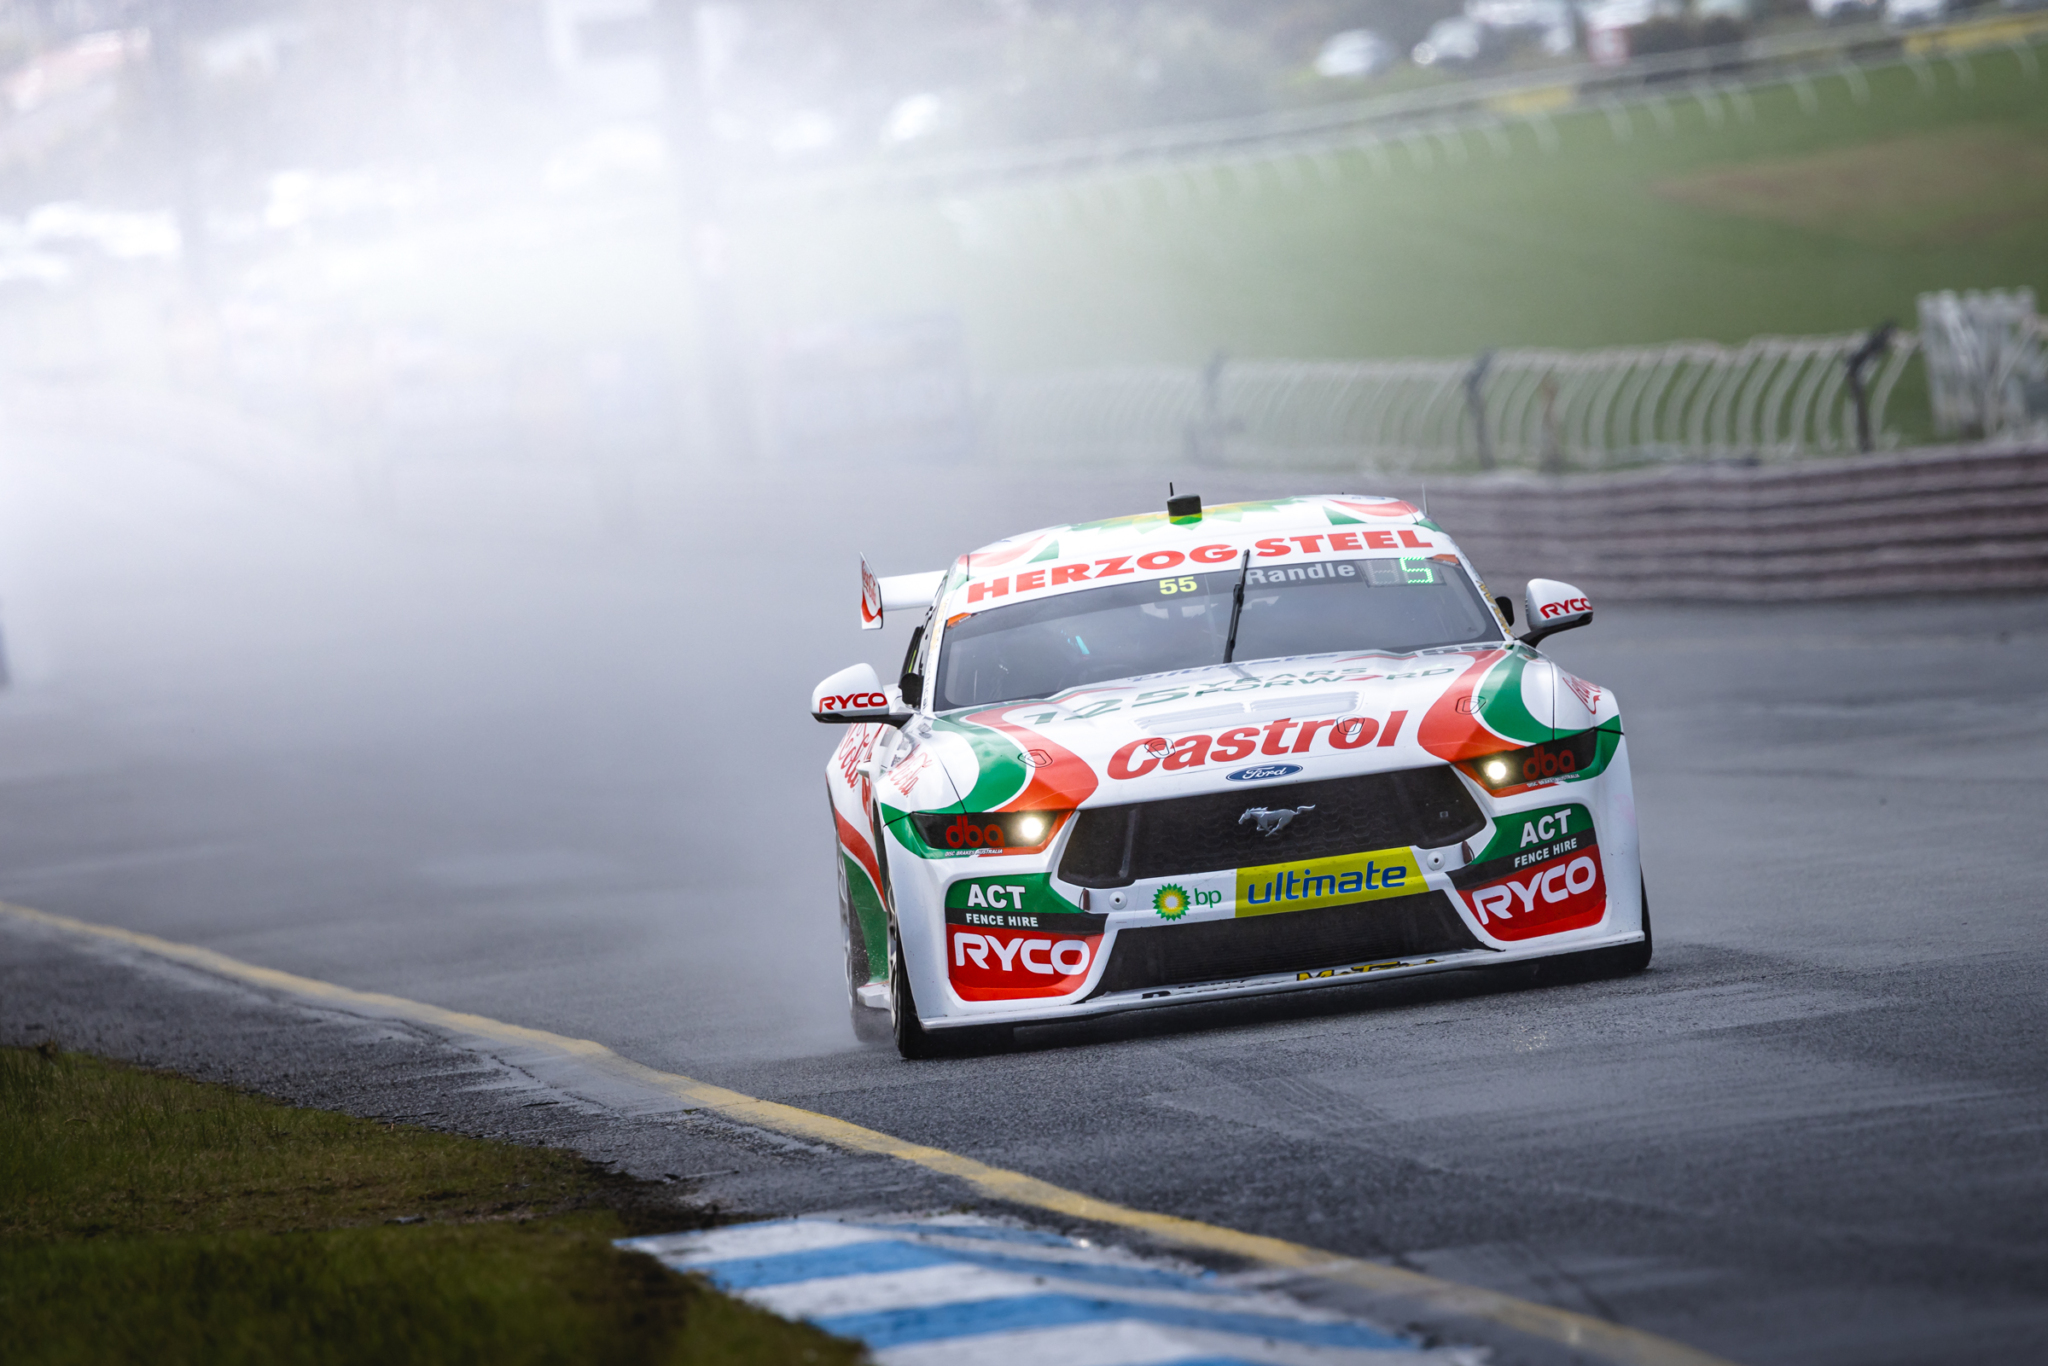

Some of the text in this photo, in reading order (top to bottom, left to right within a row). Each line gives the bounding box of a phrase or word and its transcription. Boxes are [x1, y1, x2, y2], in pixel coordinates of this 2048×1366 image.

[967, 530, 1433, 604] HERZOG STEEL
[1247, 562, 1355, 585] Randle
[1159, 576, 1198, 595] 55
[819, 692, 888, 713] RYCO
[1023, 686, 1190, 725] 125
[1106, 710, 1409, 780] Castrol
[1242, 766, 1287, 780] Ford
[1523, 745, 1575, 780] dba
[945, 815, 1005, 848] dba
[1520, 808, 1571, 848] ACT
[1514, 838, 1577, 868] FENCE HIRE
[967, 884, 1026, 909] ACT
[1194, 888, 1222, 908] bp
[1248, 860, 1407, 905] ultimate
[1472, 856, 1596, 925] RYCO
[966, 913, 1038, 927] FENCE HIRE
[954, 932, 1090, 975] RYCO
